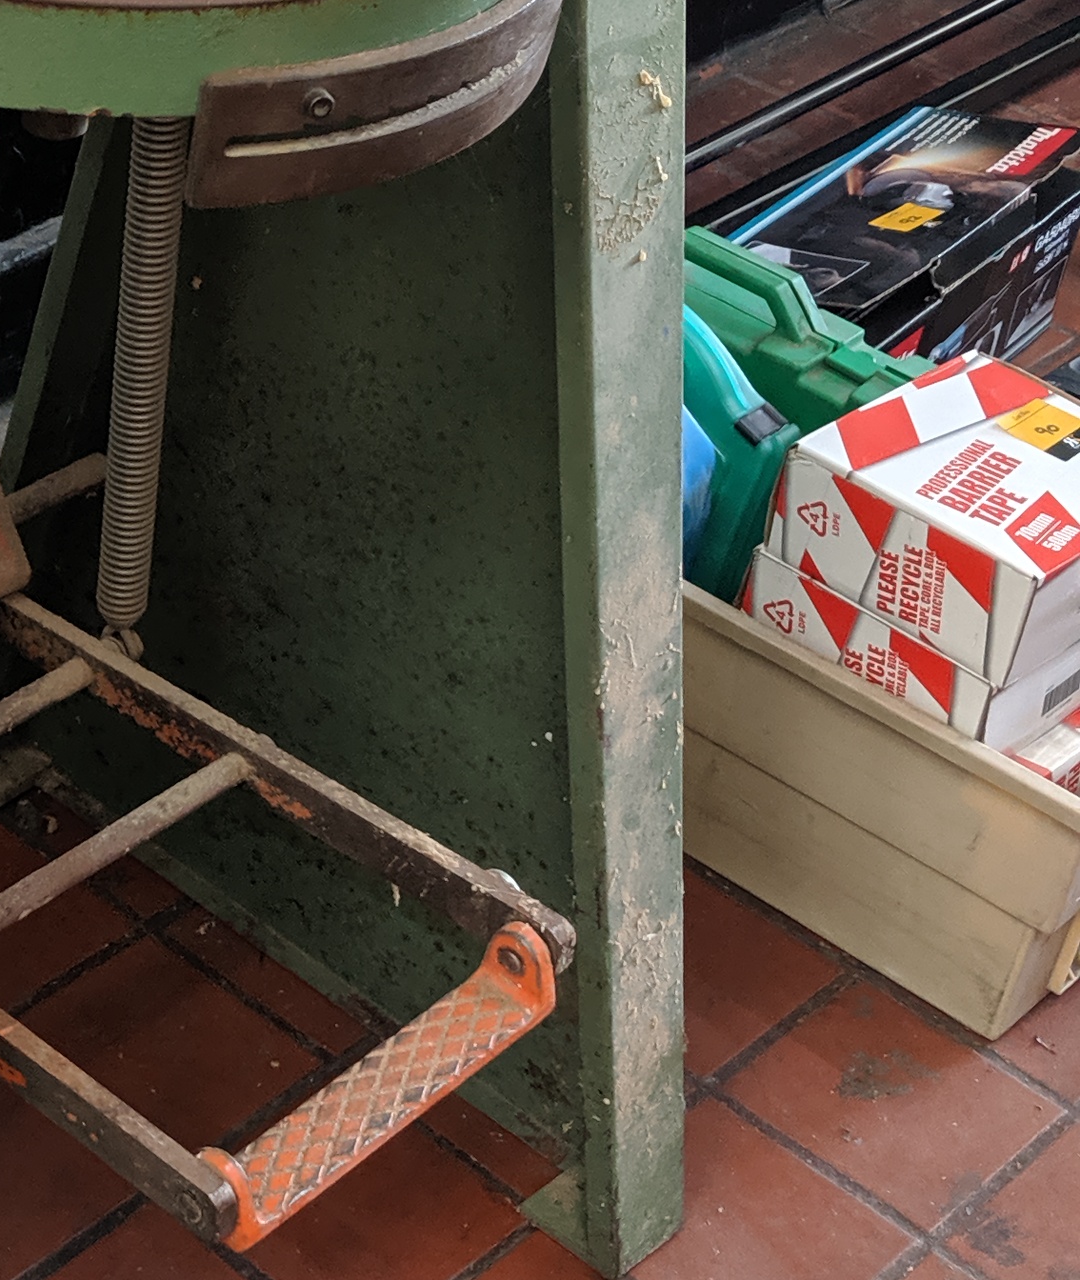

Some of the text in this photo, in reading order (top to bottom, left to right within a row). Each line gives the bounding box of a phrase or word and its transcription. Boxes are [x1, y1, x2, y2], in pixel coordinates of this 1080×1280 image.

[915, 438, 995, 500] PROFESSIONAL
[936, 451, 1023, 514] BARRIER
[831, 512, 842, 537] LDPE
[968, 487, 1029, 527] TAPE
[924, 549, 937, 571] BOX
[876, 549, 900, 616] PLEASE
[898, 543, 924, 625] RECYCLE
[920, 579, 933, 605] CORE
[930, 560, 947, 635] ALL RECYCLABLE
[918, 605, 931, 629] TAPE
[865, 643, 886, 688] YCLE
[895, 660, 910, 699] YCLABLE
